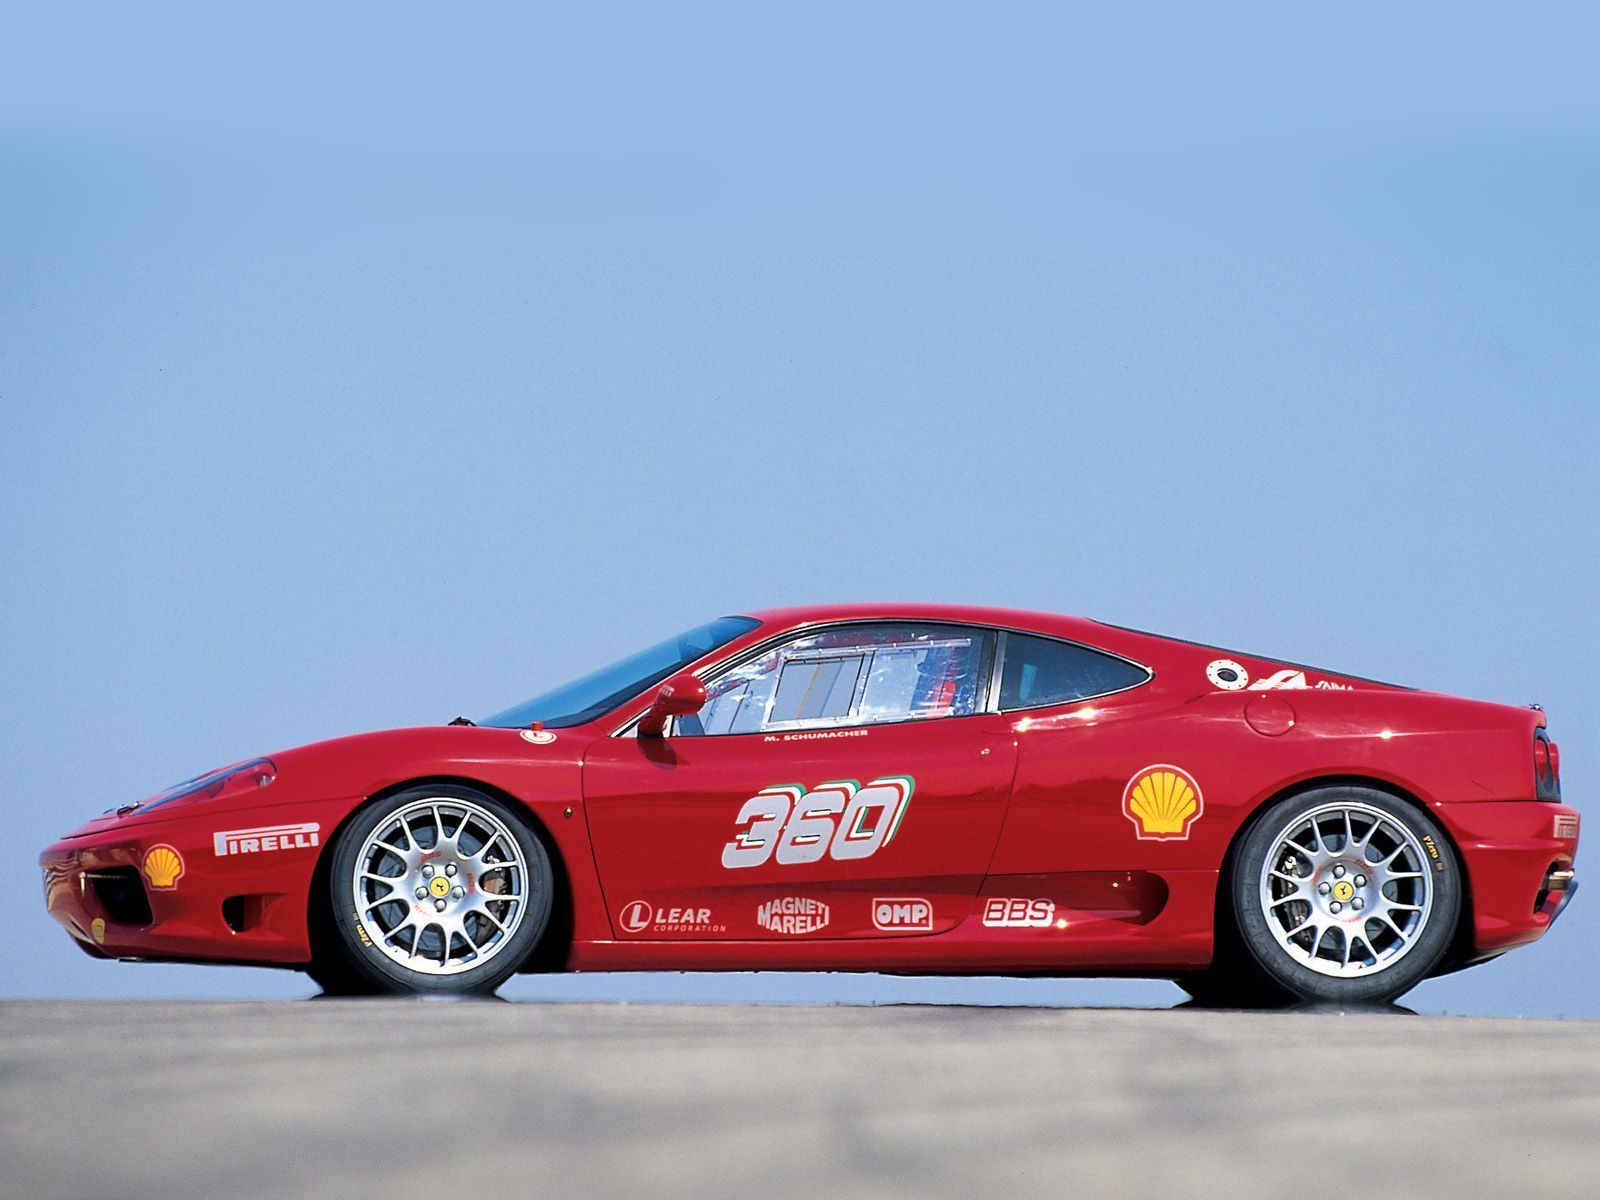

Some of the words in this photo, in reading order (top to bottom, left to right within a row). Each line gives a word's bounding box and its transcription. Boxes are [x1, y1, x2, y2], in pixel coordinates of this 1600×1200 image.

[784, 730, 868, 741] SCHUMACHER
[721, 775, 915, 869] 360
[213, 822, 320, 857] PIRELLI
[655, 908, 711, 923] LEAR
[876, 904, 928, 924] OMP
[982, 898, 1055, 927] BBS
